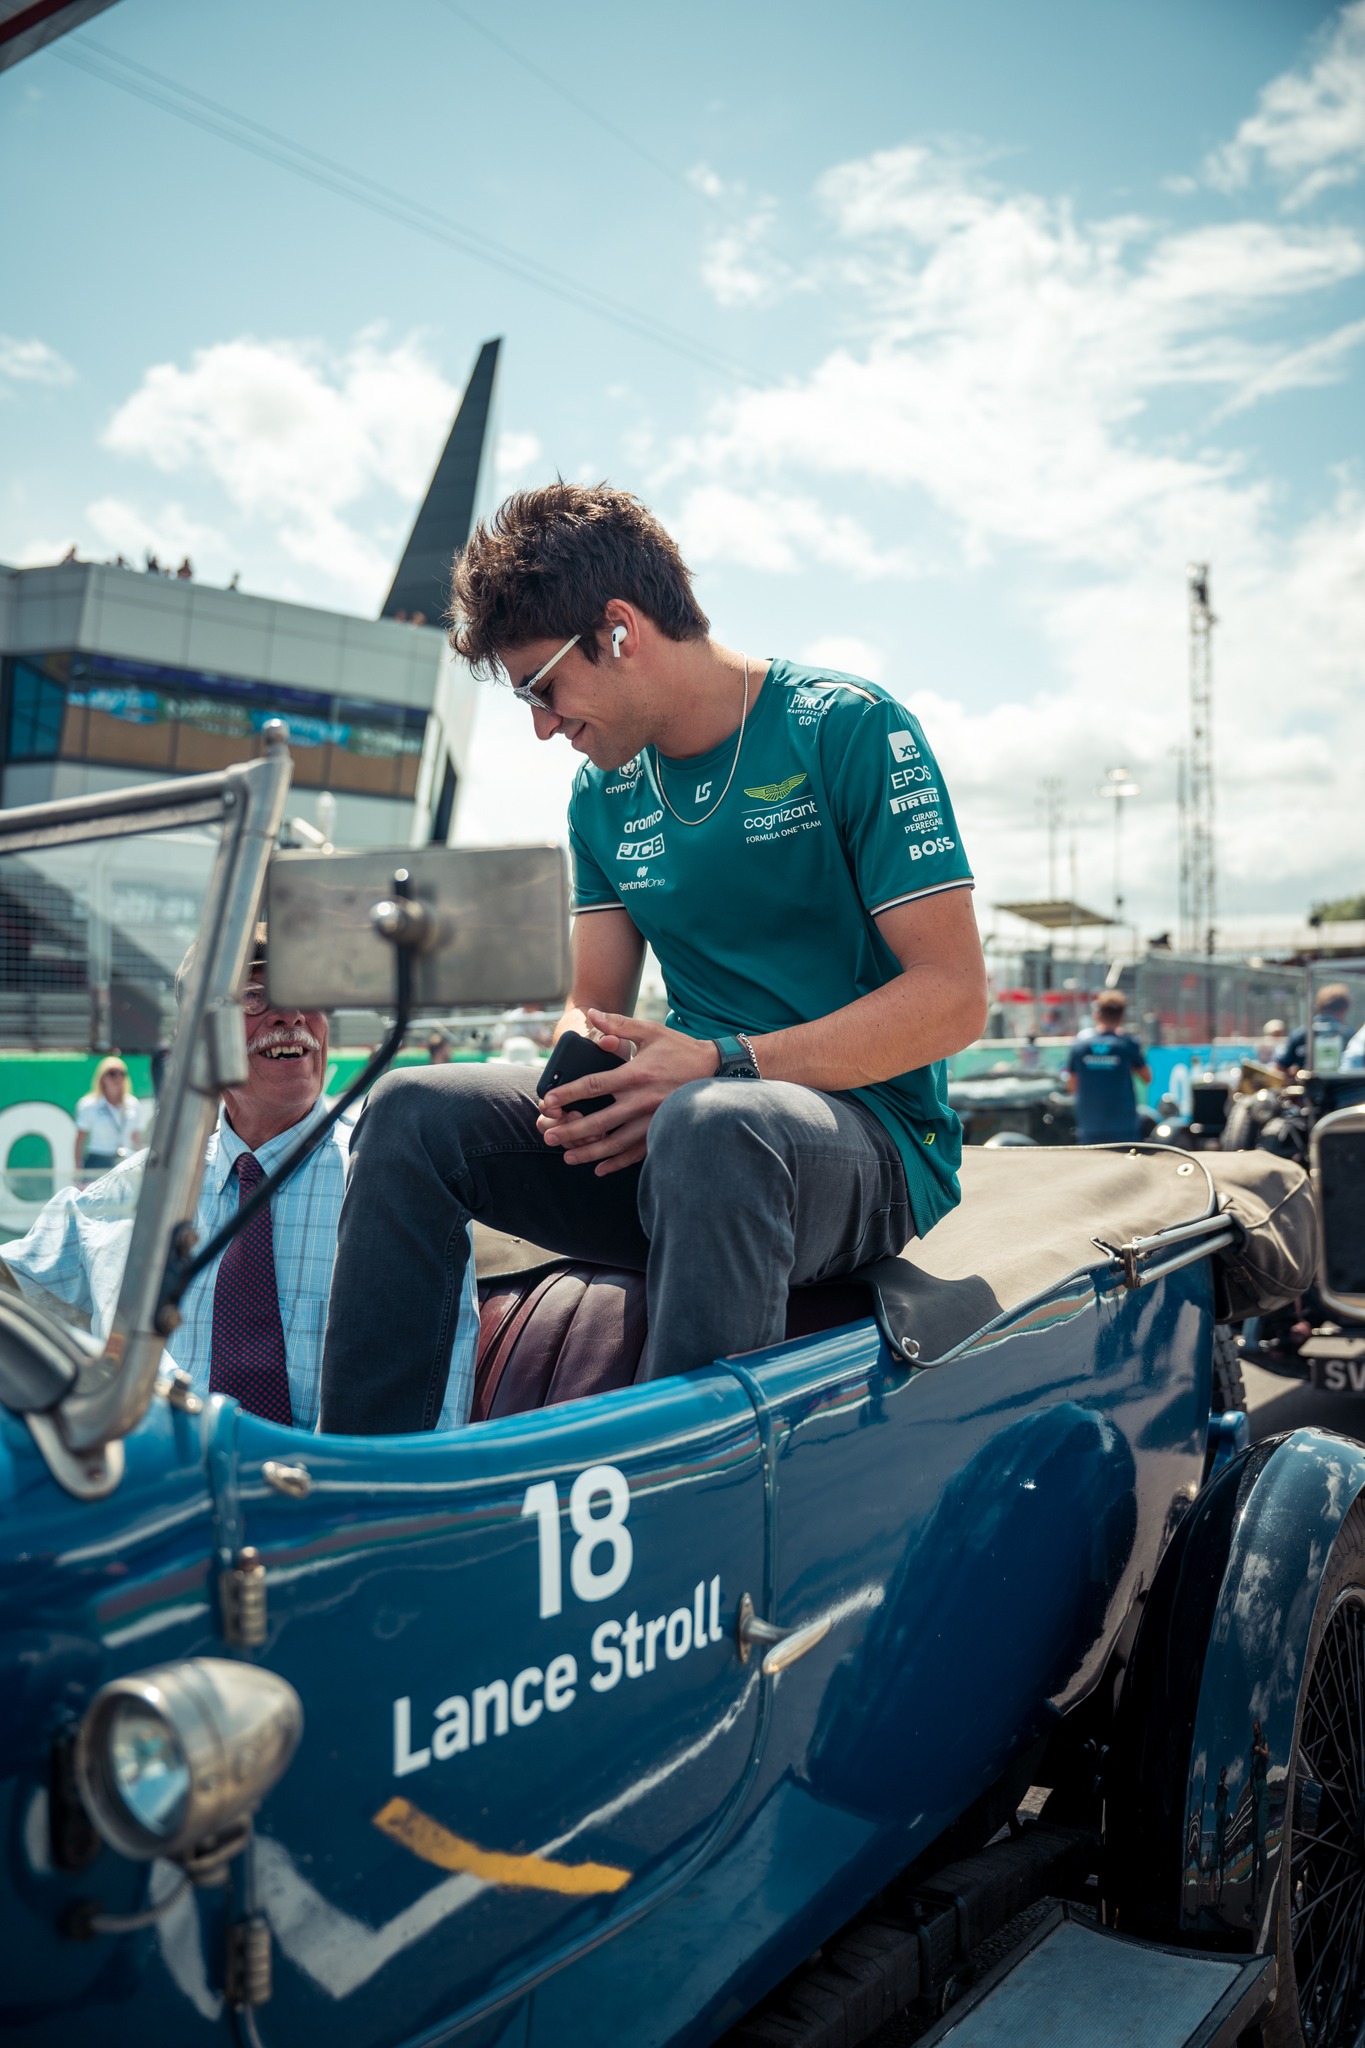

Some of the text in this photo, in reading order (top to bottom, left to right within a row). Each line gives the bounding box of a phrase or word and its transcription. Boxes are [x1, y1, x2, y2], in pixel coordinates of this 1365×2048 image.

[890, 765, 931, 790] EPOS
[623, 809, 664, 834] aramco
[743, 800, 818, 830] cognizant
[912, 810, 939, 822] GIRARD
[745, 831, 781, 844] FORMULA
[800, 820, 822, 831] TEAM
[617, 834, 664, 859] JCB
[908, 836, 956, 861] BOSS
[520, 1464, 634, 1620] 18
[392, 1573, 724, 1778] Lance Stroll
